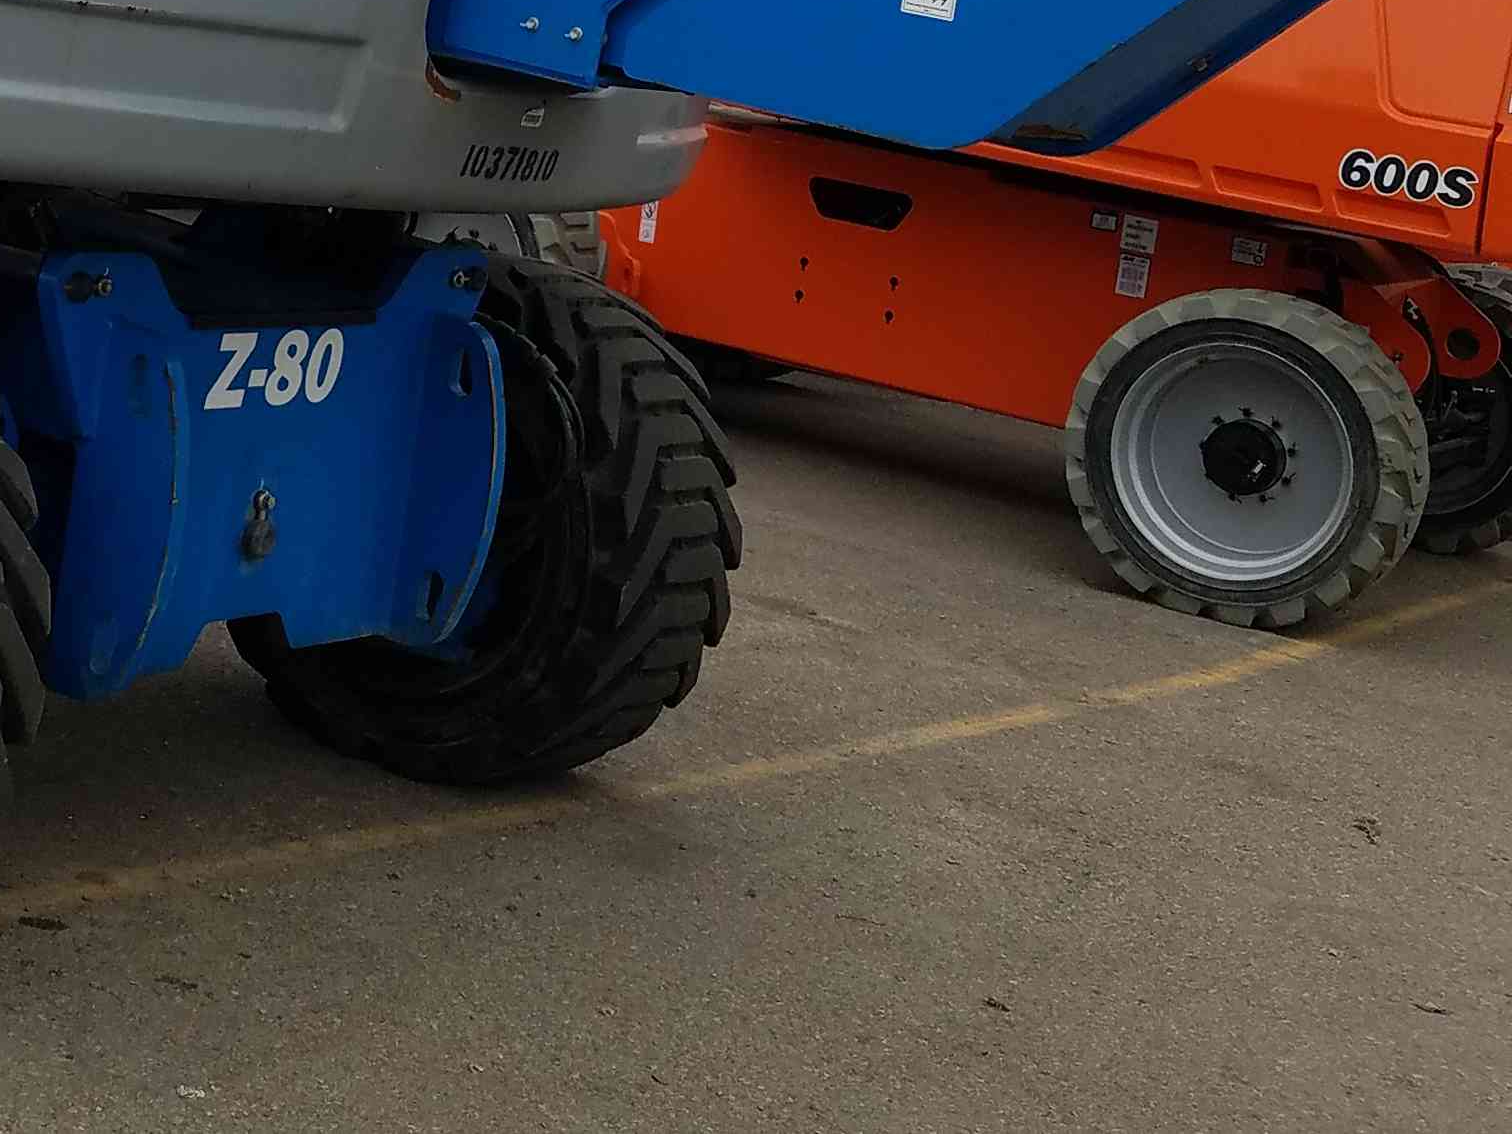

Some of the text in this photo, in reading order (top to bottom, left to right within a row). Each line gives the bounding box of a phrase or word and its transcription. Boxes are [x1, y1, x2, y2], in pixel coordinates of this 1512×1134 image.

[460, 144, 559, 181] 10371810
[1341, 150, 1478, 207] 600S
[203, 327, 344, 411] Z-80
